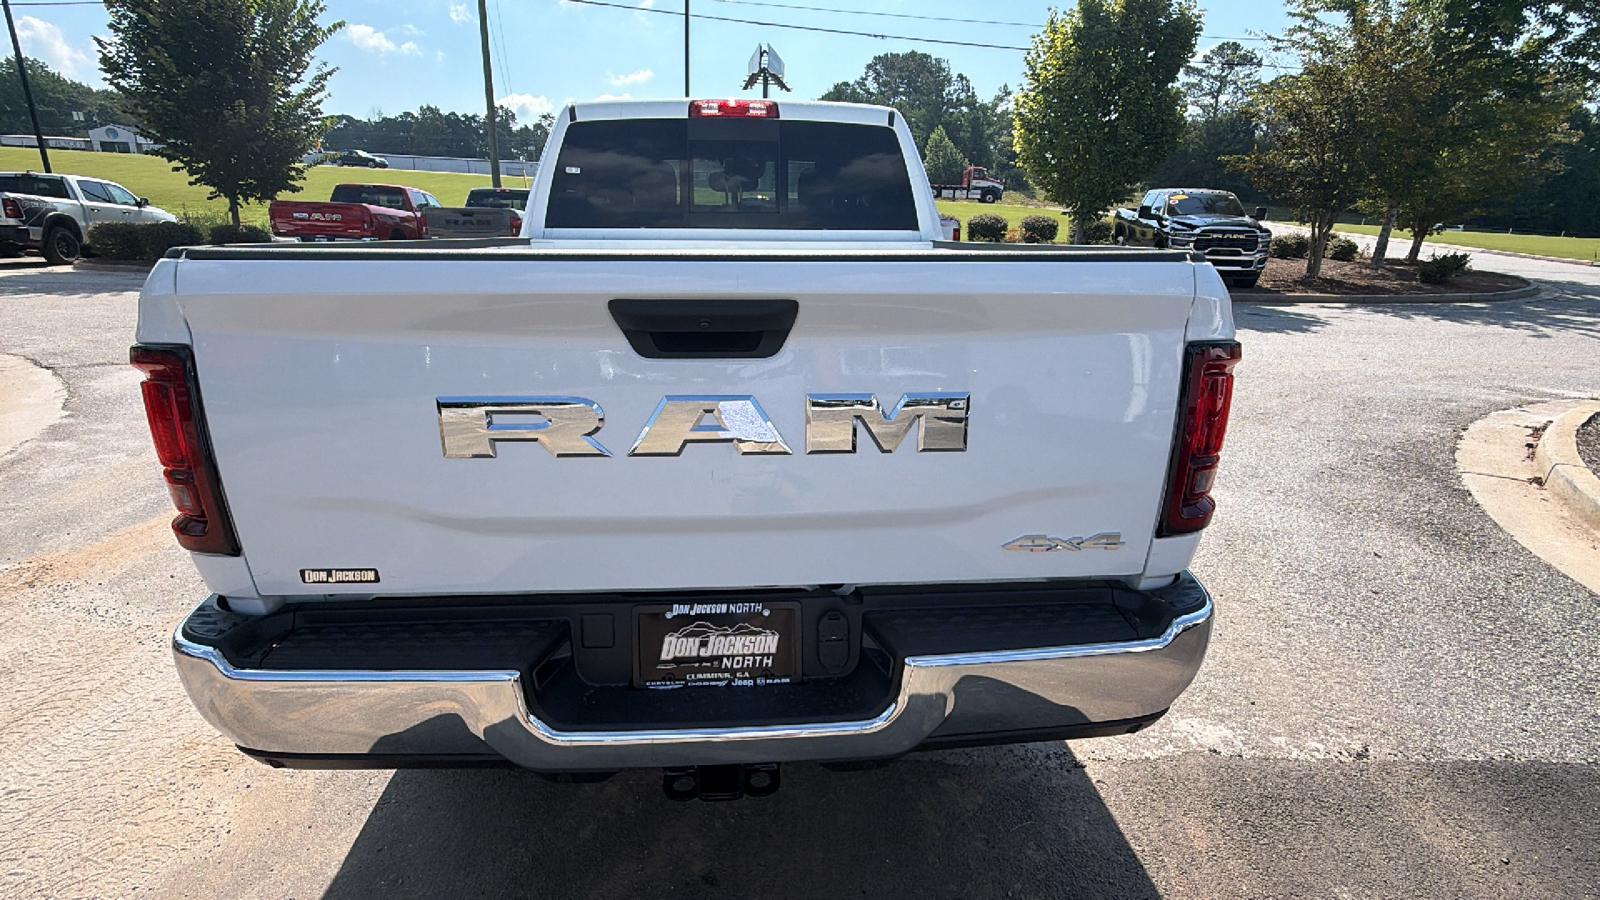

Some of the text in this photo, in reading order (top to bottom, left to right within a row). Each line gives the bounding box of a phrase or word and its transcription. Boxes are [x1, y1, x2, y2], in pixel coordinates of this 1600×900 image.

[293, 212, 342, 221] RAM
[436, 392, 971, 458] RAM
[304, 569, 375, 583] DON JACKSON
[672, 602, 763, 616] DON JACKSON NORTH
[660, 634, 780, 660] DON JACKSON
[721, 655, 773, 669] NORTH
[731, 678, 754, 687] Jeep
